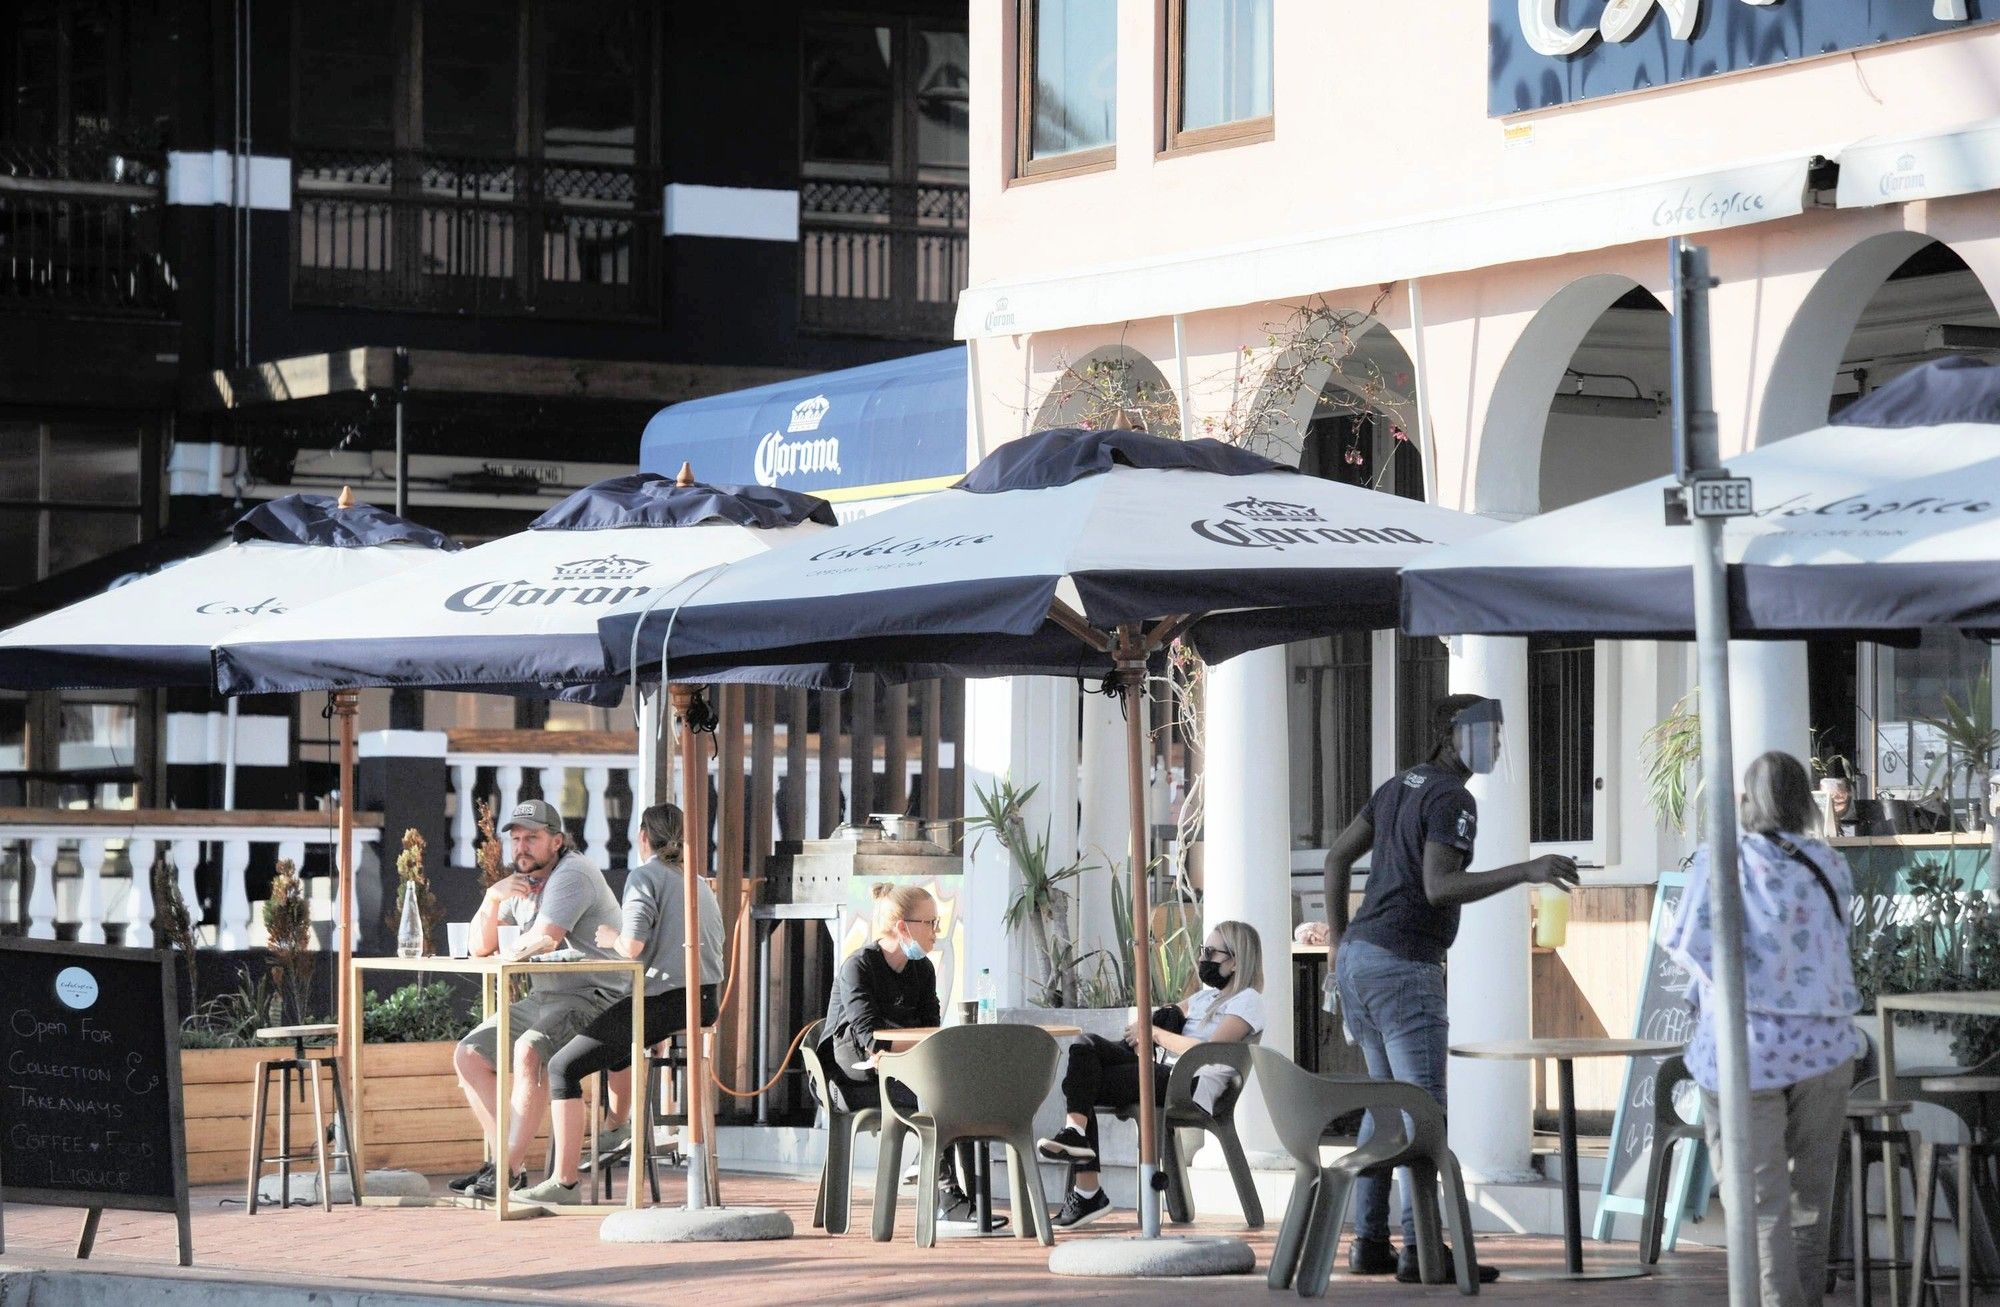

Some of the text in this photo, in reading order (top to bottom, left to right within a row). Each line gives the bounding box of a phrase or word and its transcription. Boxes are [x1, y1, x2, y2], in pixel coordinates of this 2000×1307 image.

[985, 311, 1016, 332] Corona
[754, 430, 841, 488] Corona
[1700, 484, 1748, 510] FREE
[1190, 519, 1434, 551] Corona
[444, 579, 653, 616] Coron
